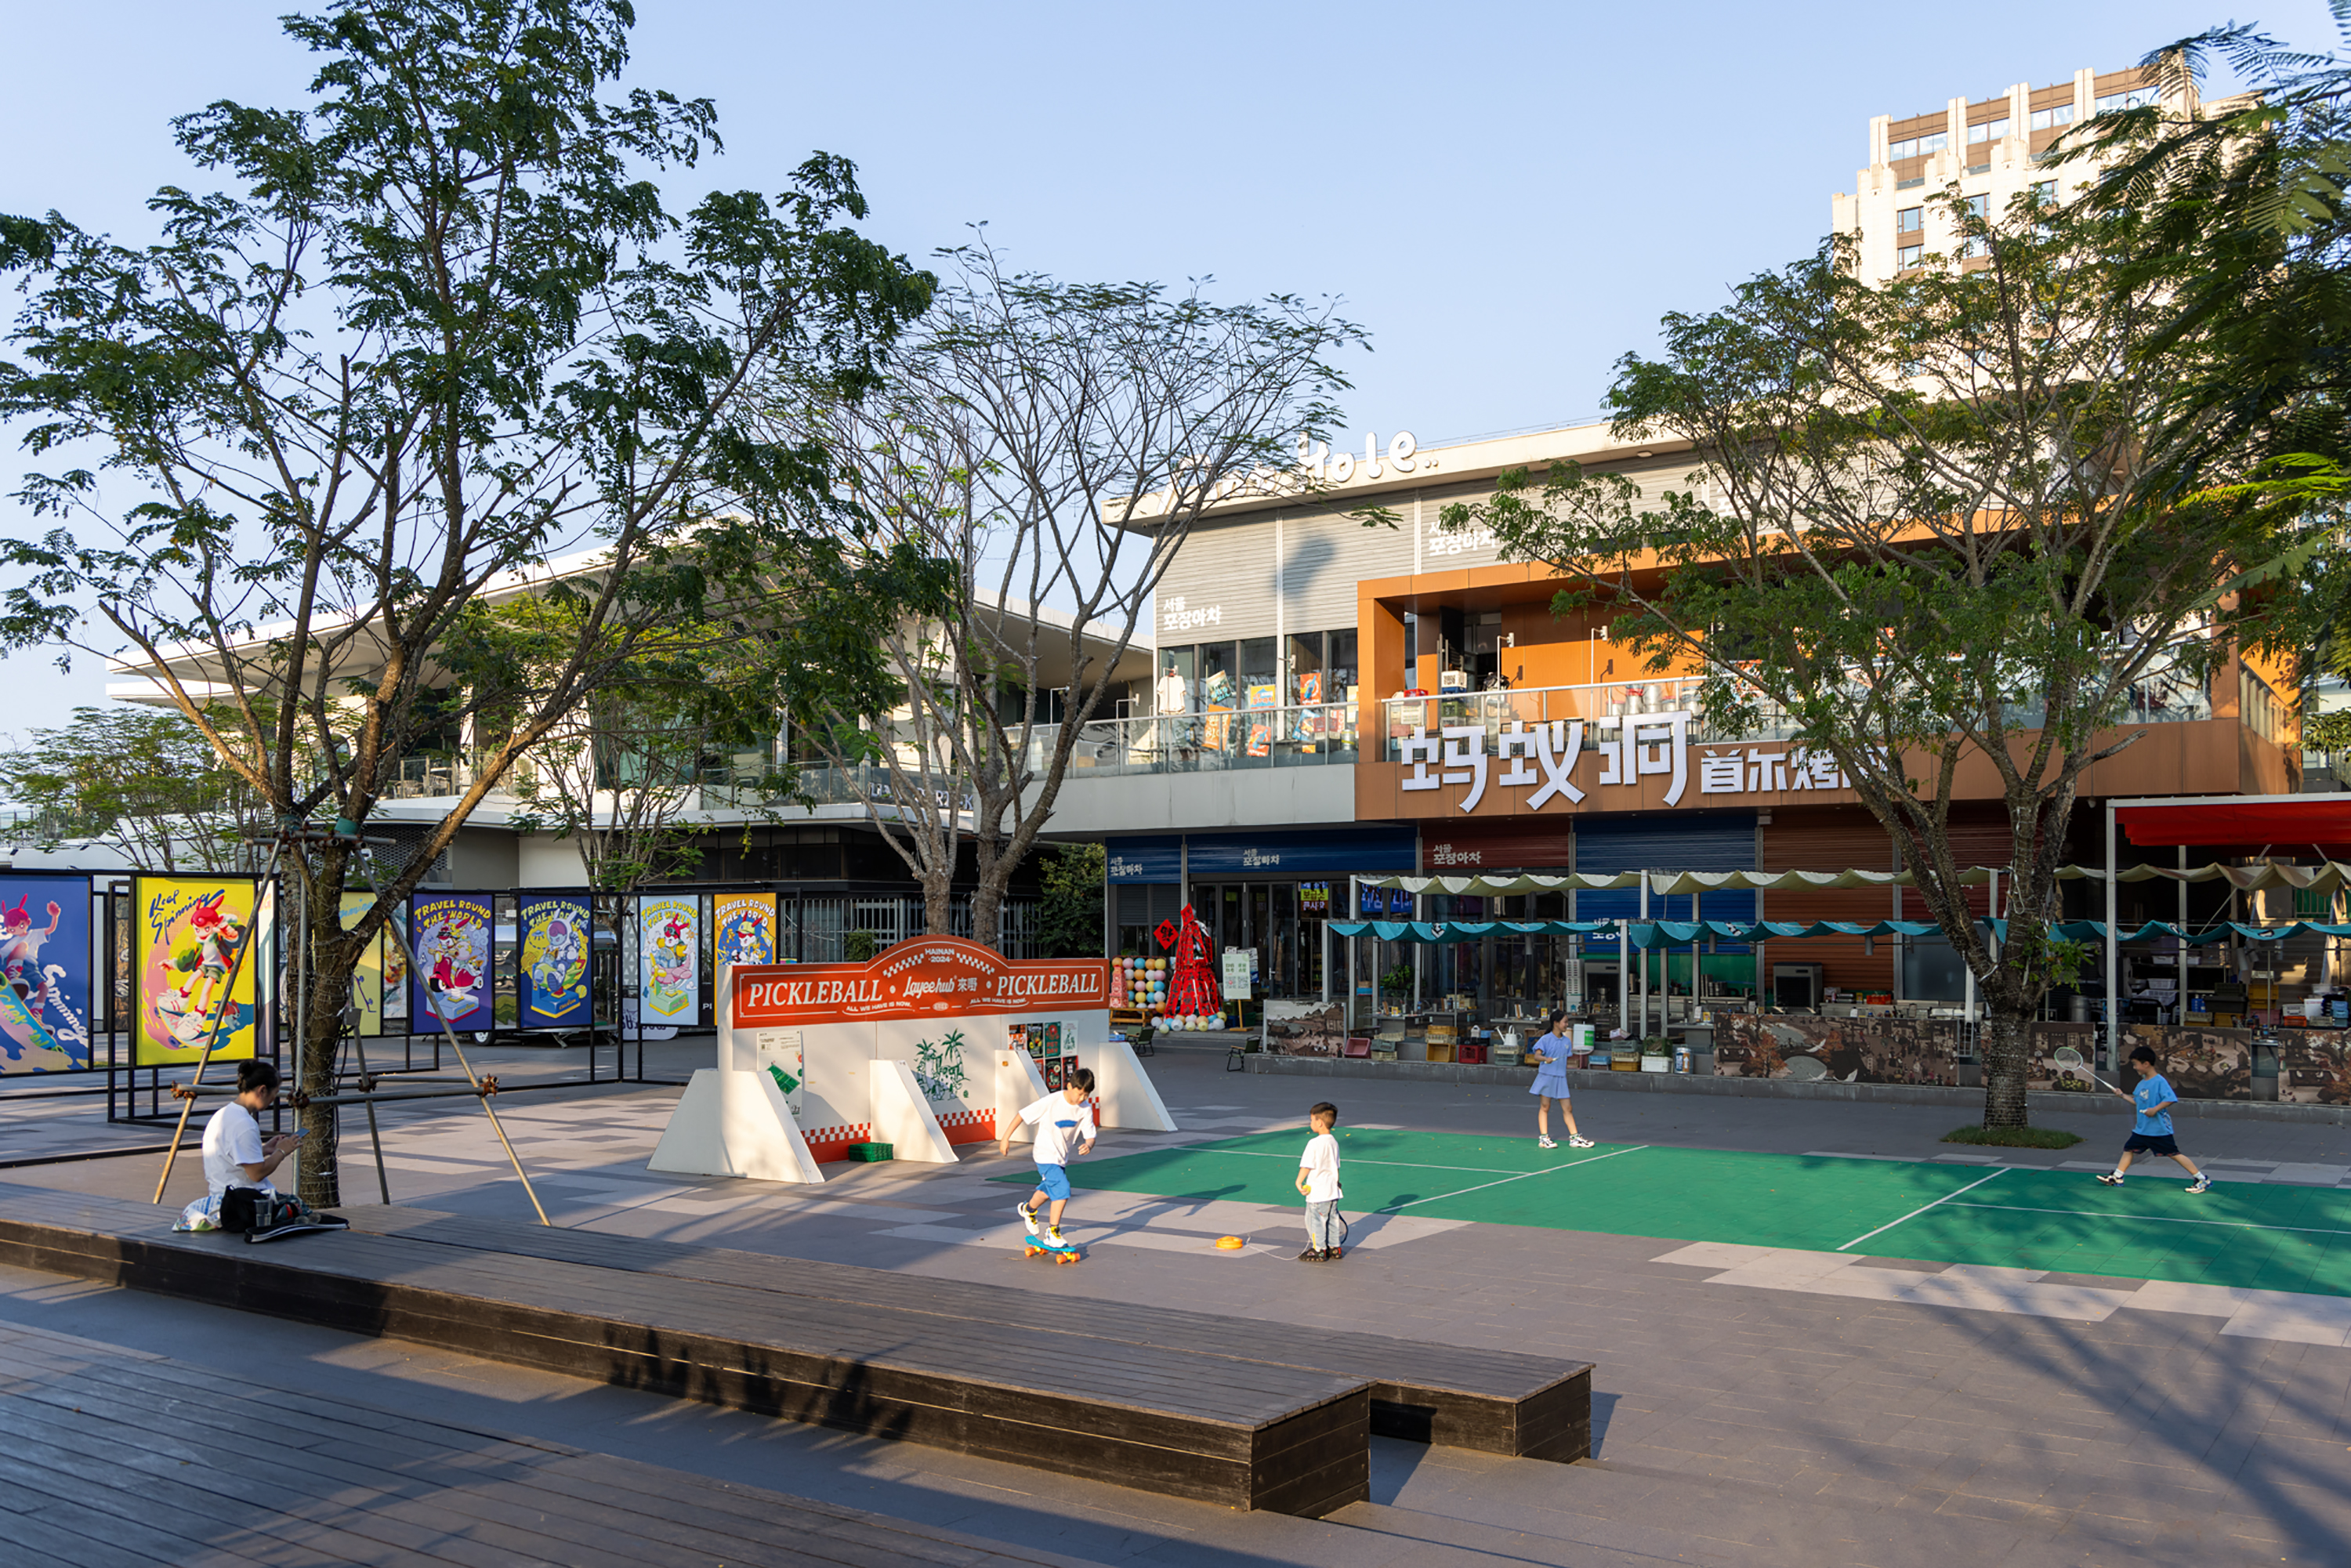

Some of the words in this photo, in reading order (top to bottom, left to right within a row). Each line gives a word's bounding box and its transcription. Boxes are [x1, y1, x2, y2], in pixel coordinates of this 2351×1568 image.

[1163, 596, 1186, 612] 서울
[1401, 709, 1693, 813] 蚂蚁洞
[1701, 744, 1889, 794] 首尔烤
[415, 899, 456, 921] TRAVEL
[458, 900, 491, 920] ROUND
[423, 911, 444, 929] THE
[520, 900, 559, 921] TRAVEL
[560, 900, 591, 919] ROUND
[529, 911, 549, 929] THE
[641, 900, 672, 922] TRAVEL
[672, 900, 698, 919] ROUND
[647, 911, 663, 929] THE
[715, 899, 747, 921] TRAVEL
[748, 899, 776, 918] ROUND
[722, 911, 738, 928] THE
[748, 980, 882, 1007] PICKLEBALL
[996, 973, 1099, 997] PICKLEBALL
